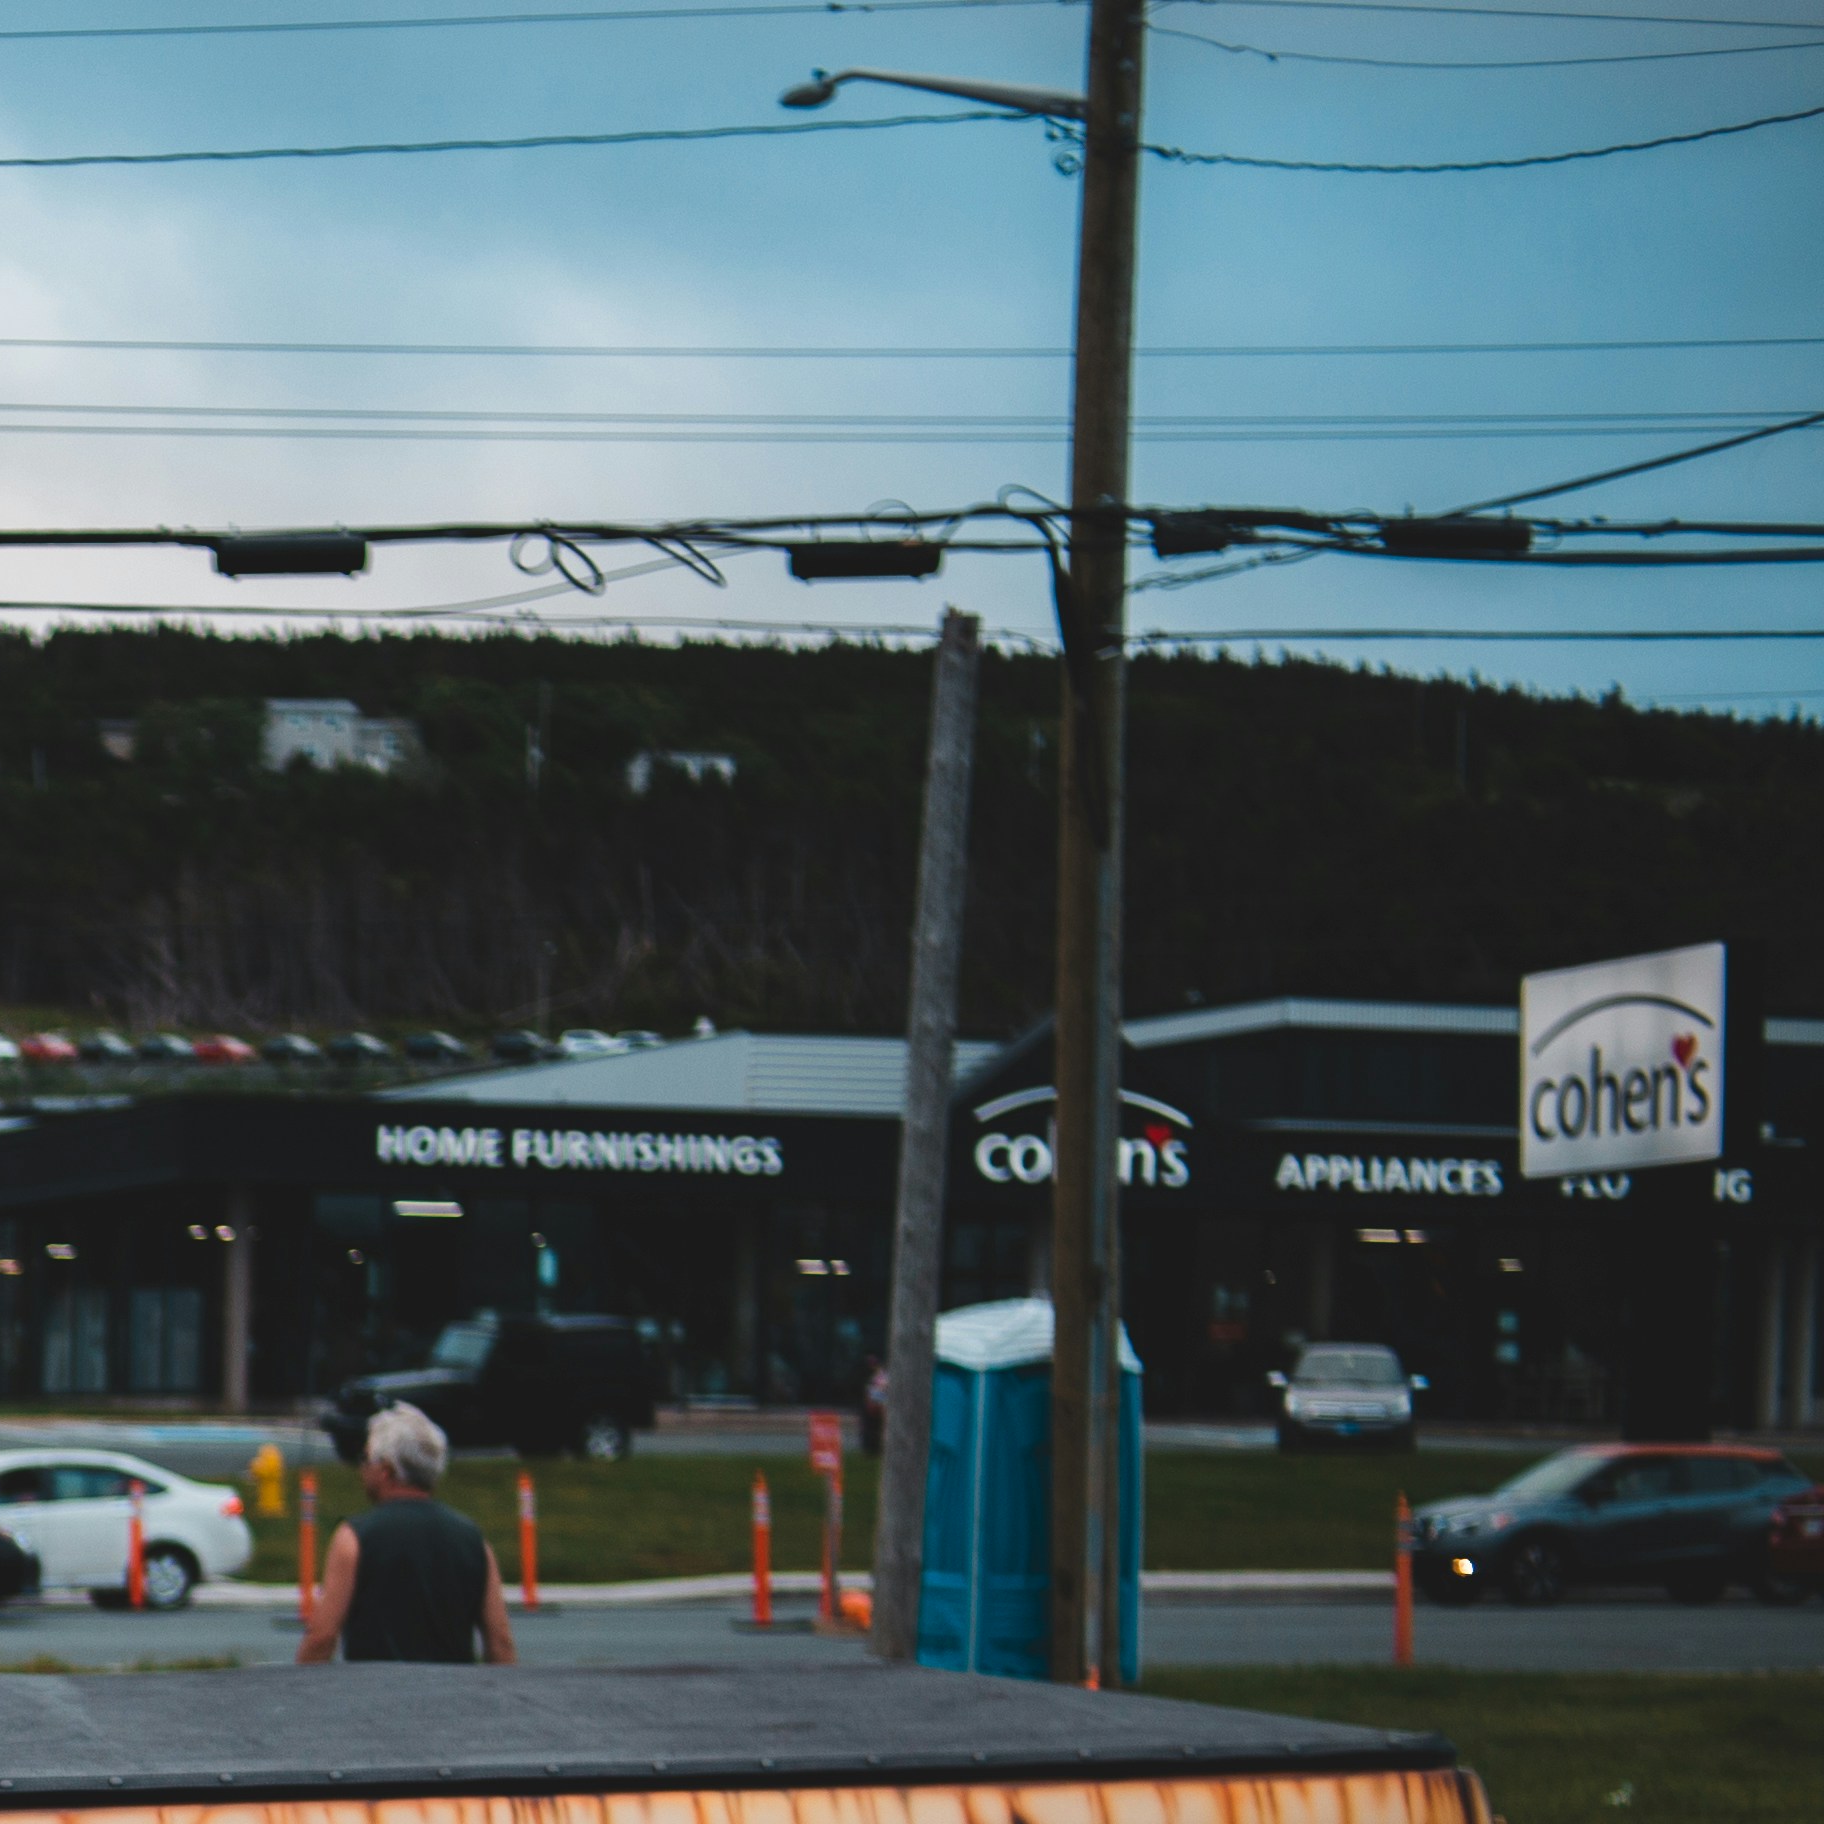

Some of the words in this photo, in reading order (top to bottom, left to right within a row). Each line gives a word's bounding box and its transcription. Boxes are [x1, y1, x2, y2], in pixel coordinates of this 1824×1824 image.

[1531, 1033, 1710, 1141] cohen's
[375, 1124, 505, 1168] HOME
[511, 1128, 784, 1176] FURNISHINGS
[1275, 1152, 1504, 1197] APPLIANCES
